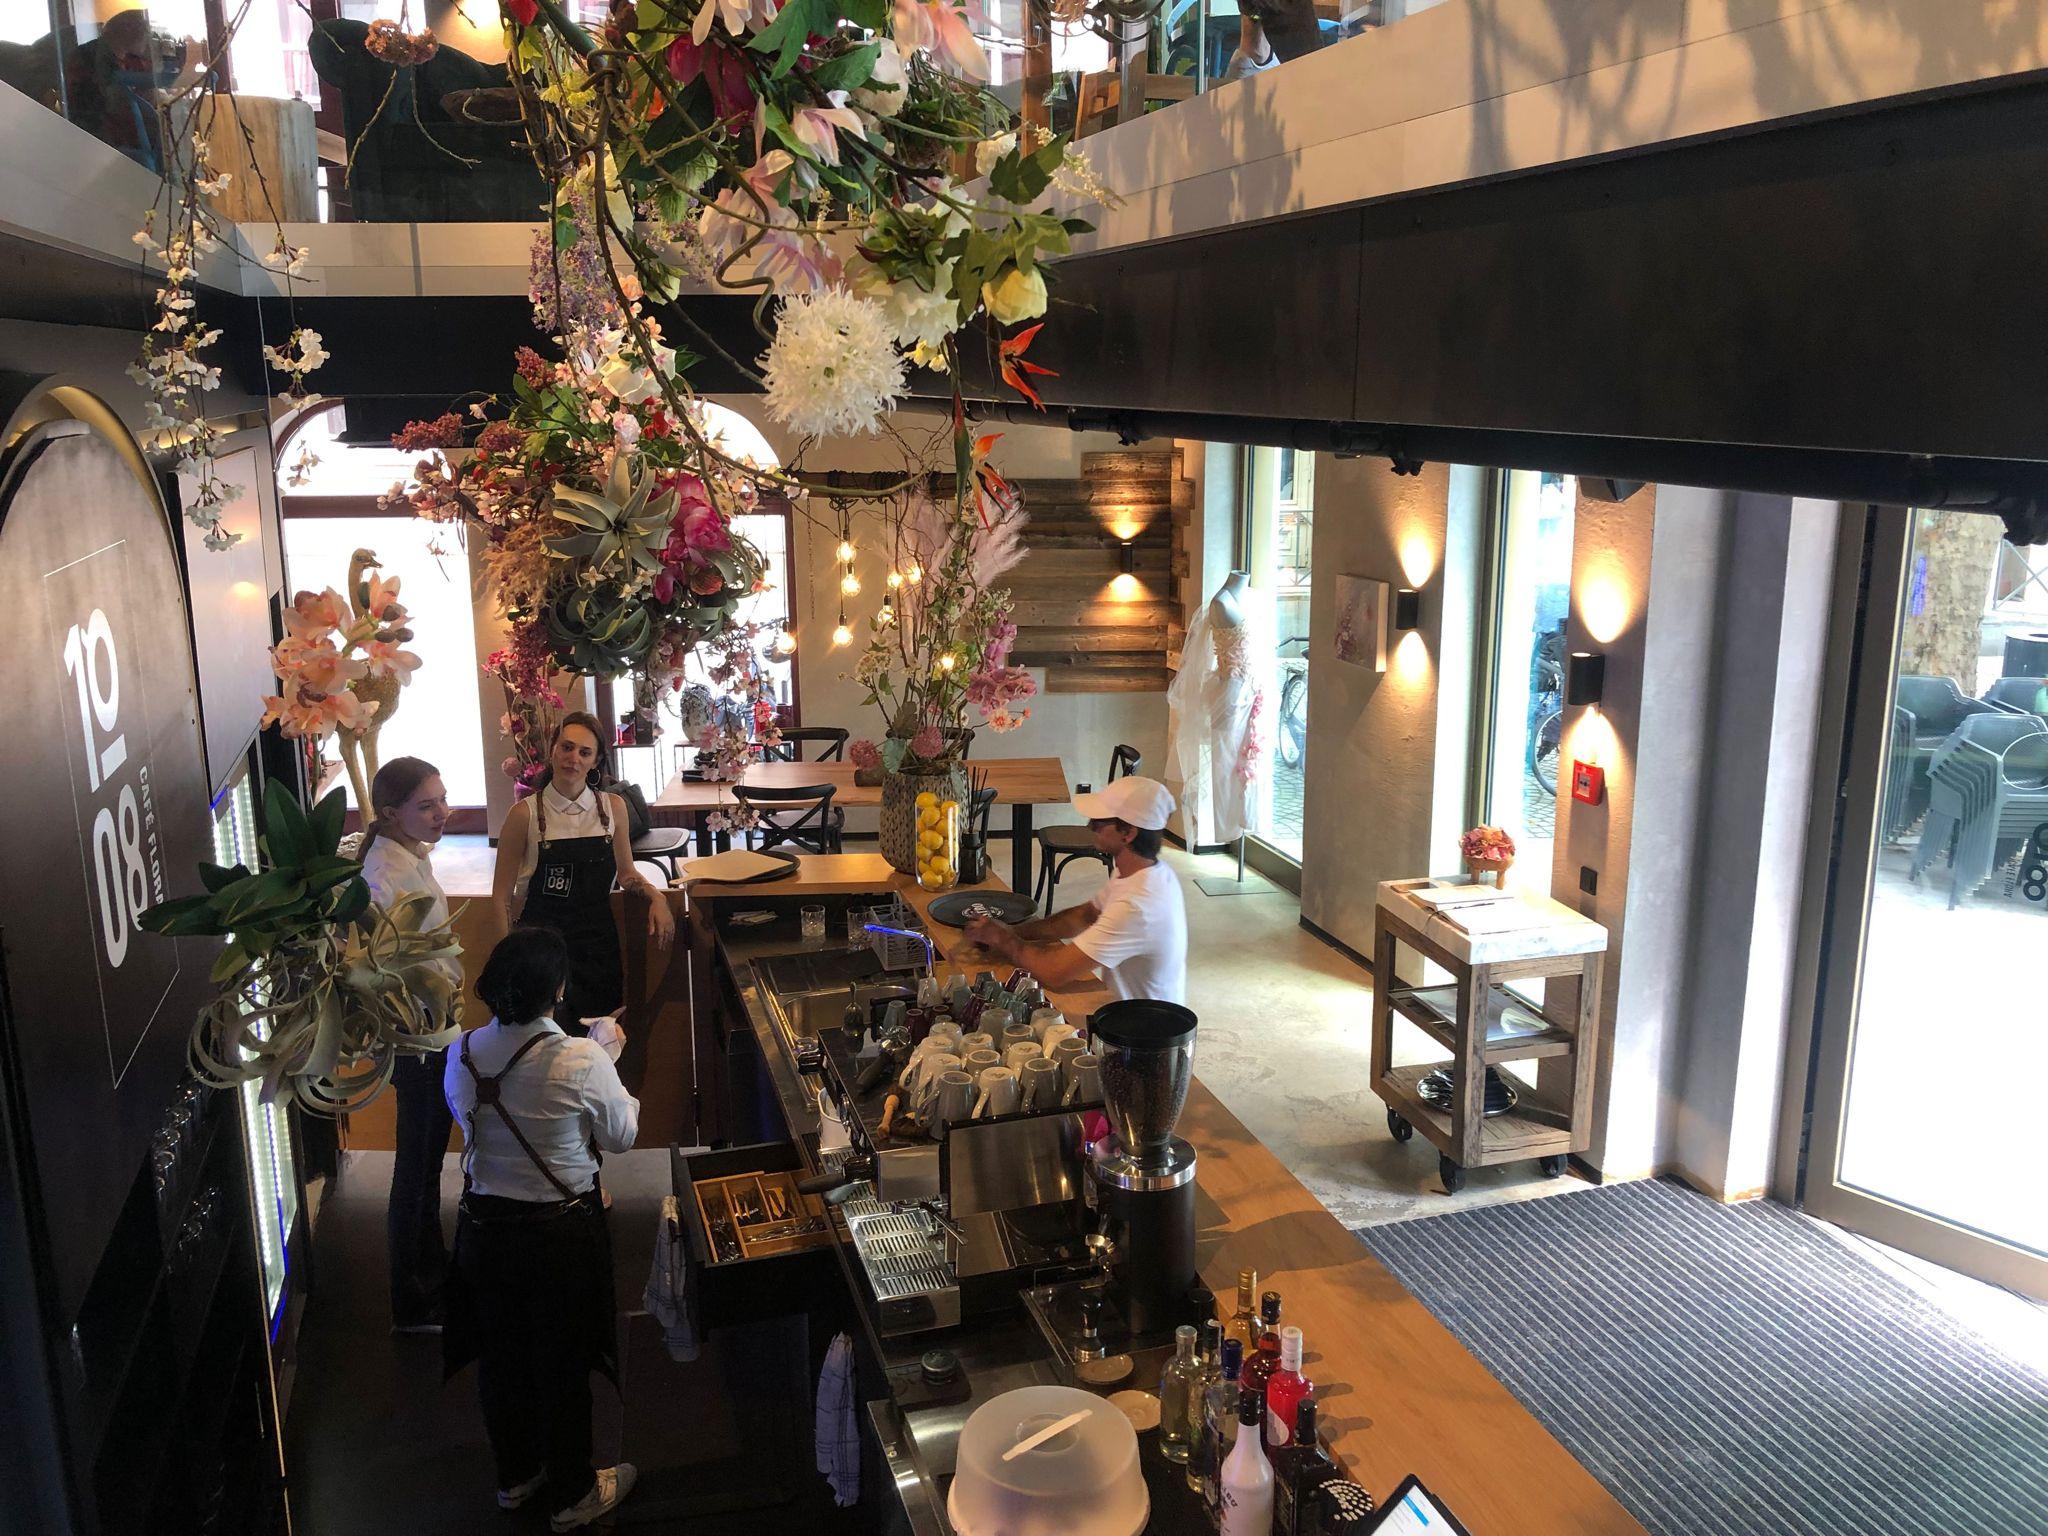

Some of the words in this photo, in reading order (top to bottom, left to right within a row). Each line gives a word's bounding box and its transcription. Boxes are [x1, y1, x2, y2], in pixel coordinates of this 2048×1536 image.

[63, 608, 119, 793] 10
[139, 765, 155, 831] CAFÉ
[93, 783, 149, 969] 08
[548, 876, 565, 890] 08
